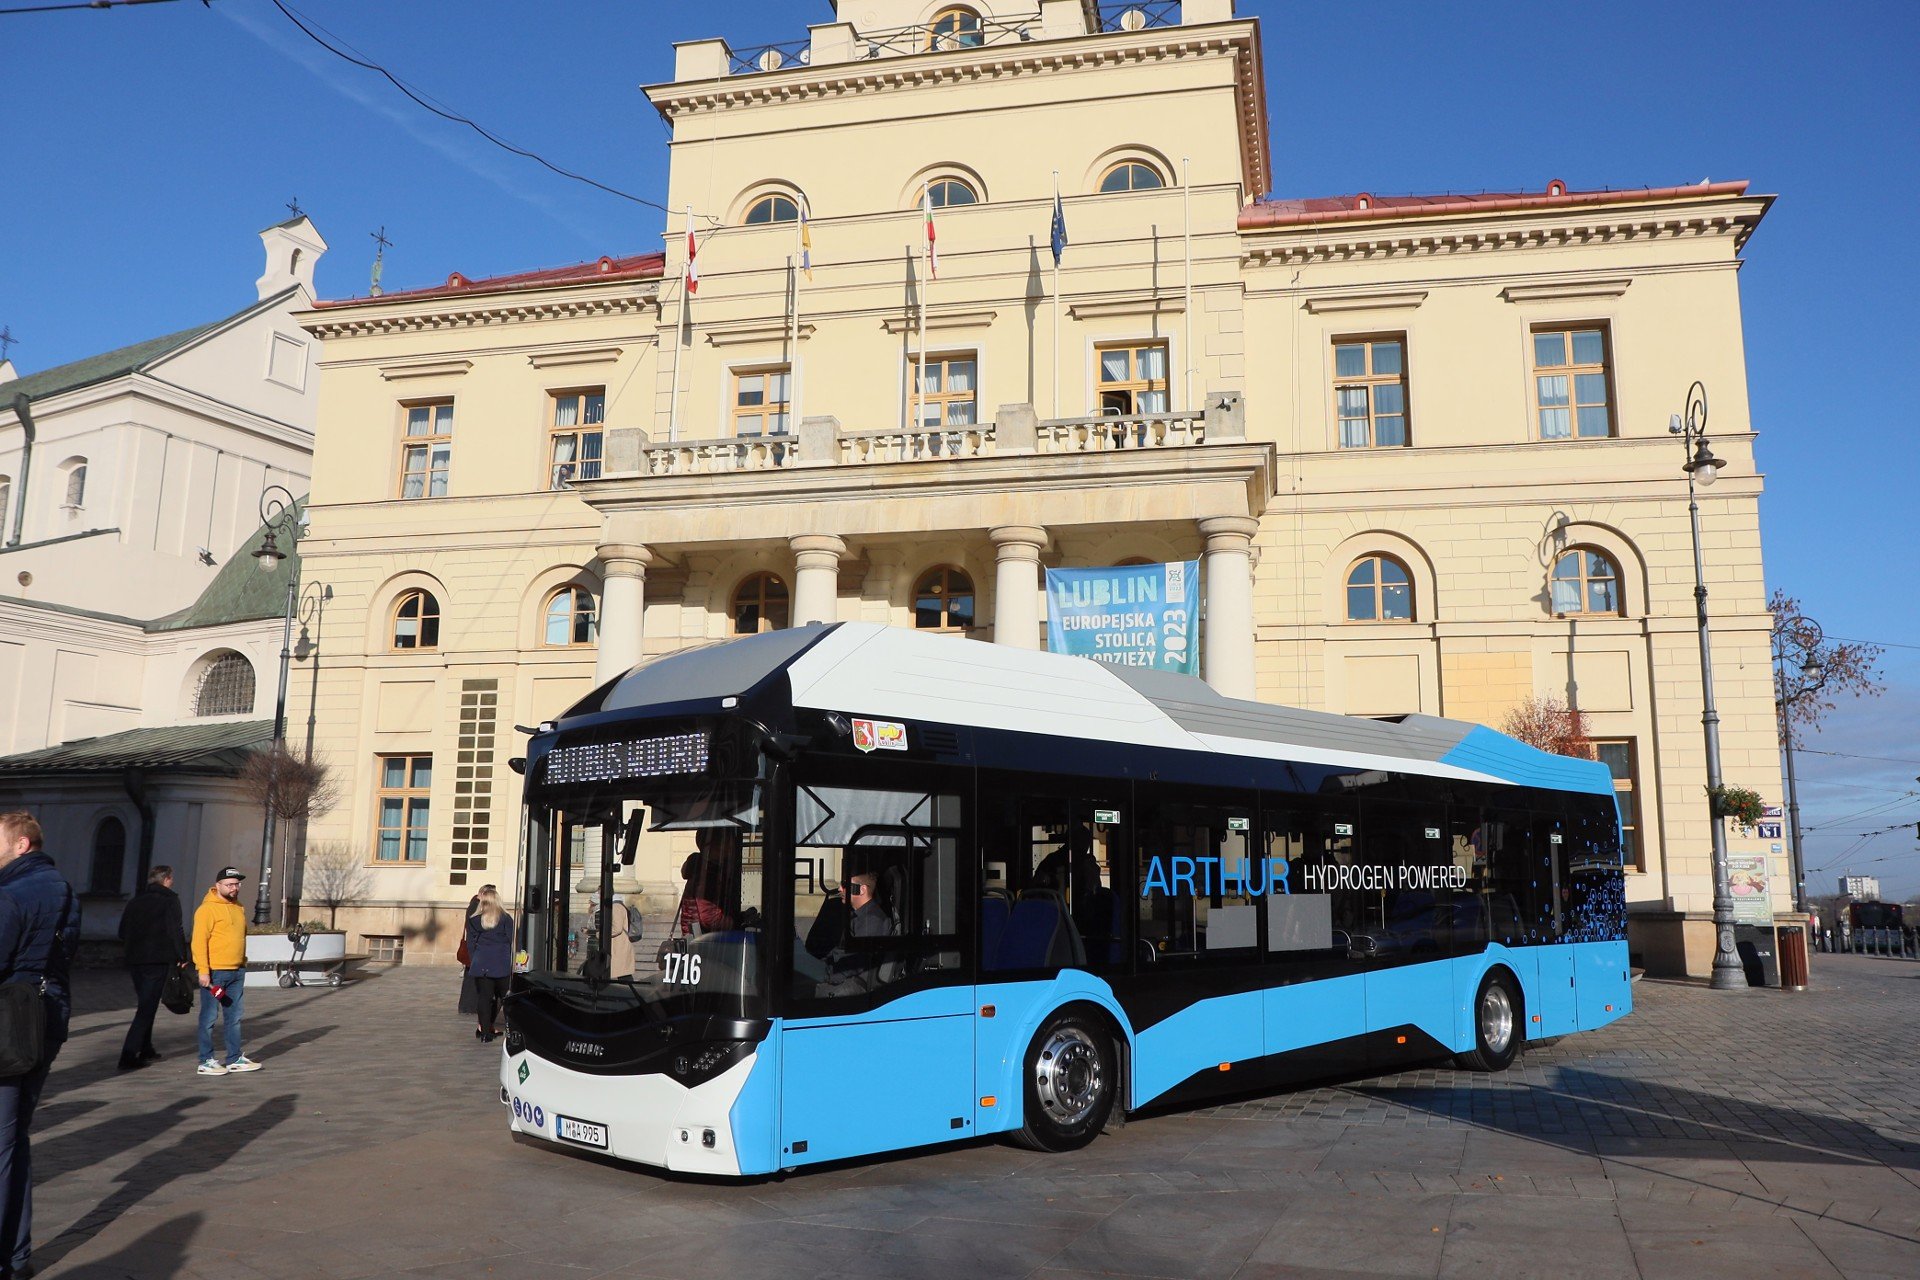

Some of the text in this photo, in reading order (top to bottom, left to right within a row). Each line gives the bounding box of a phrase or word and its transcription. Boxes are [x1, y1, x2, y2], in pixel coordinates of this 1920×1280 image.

[1058, 575, 1158, 608] LUBLIN
[1063, 612, 1156, 632] EUROPEJSKA
[1095, 632, 1156, 648] STOLICA
[1163, 609, 1187, 664] 2023
[1073, 647, 1156, 667] DZIEŻY
[1142, 855, 1467, 896] ARTHUR HYDROGEN POWERED
[663, 953, 701, 985] 1716
[583, 1125, 599, 1142] 995
